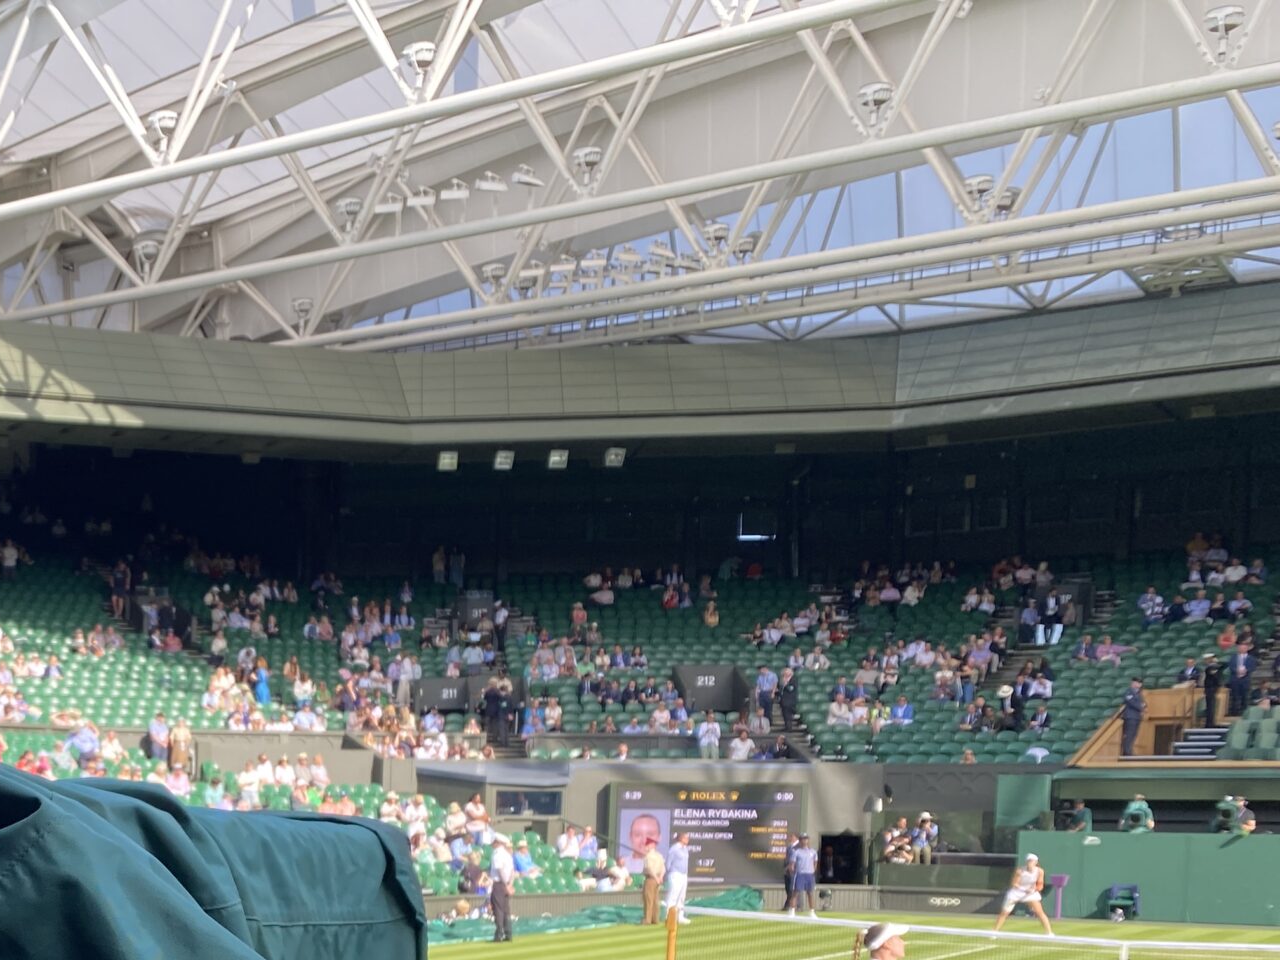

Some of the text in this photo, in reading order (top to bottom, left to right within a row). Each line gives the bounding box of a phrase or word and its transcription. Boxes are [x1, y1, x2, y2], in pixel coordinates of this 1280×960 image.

[697, 675, 716, 686] 212
[442, 688, 457, 699] 211
[691, 791, 726, 801] ROLEX
[674, 809, 758, 819] ELENA RYBAKINA
[715, 832, 733, 840] OPEN
[930, 897, 961, 907] oppo
